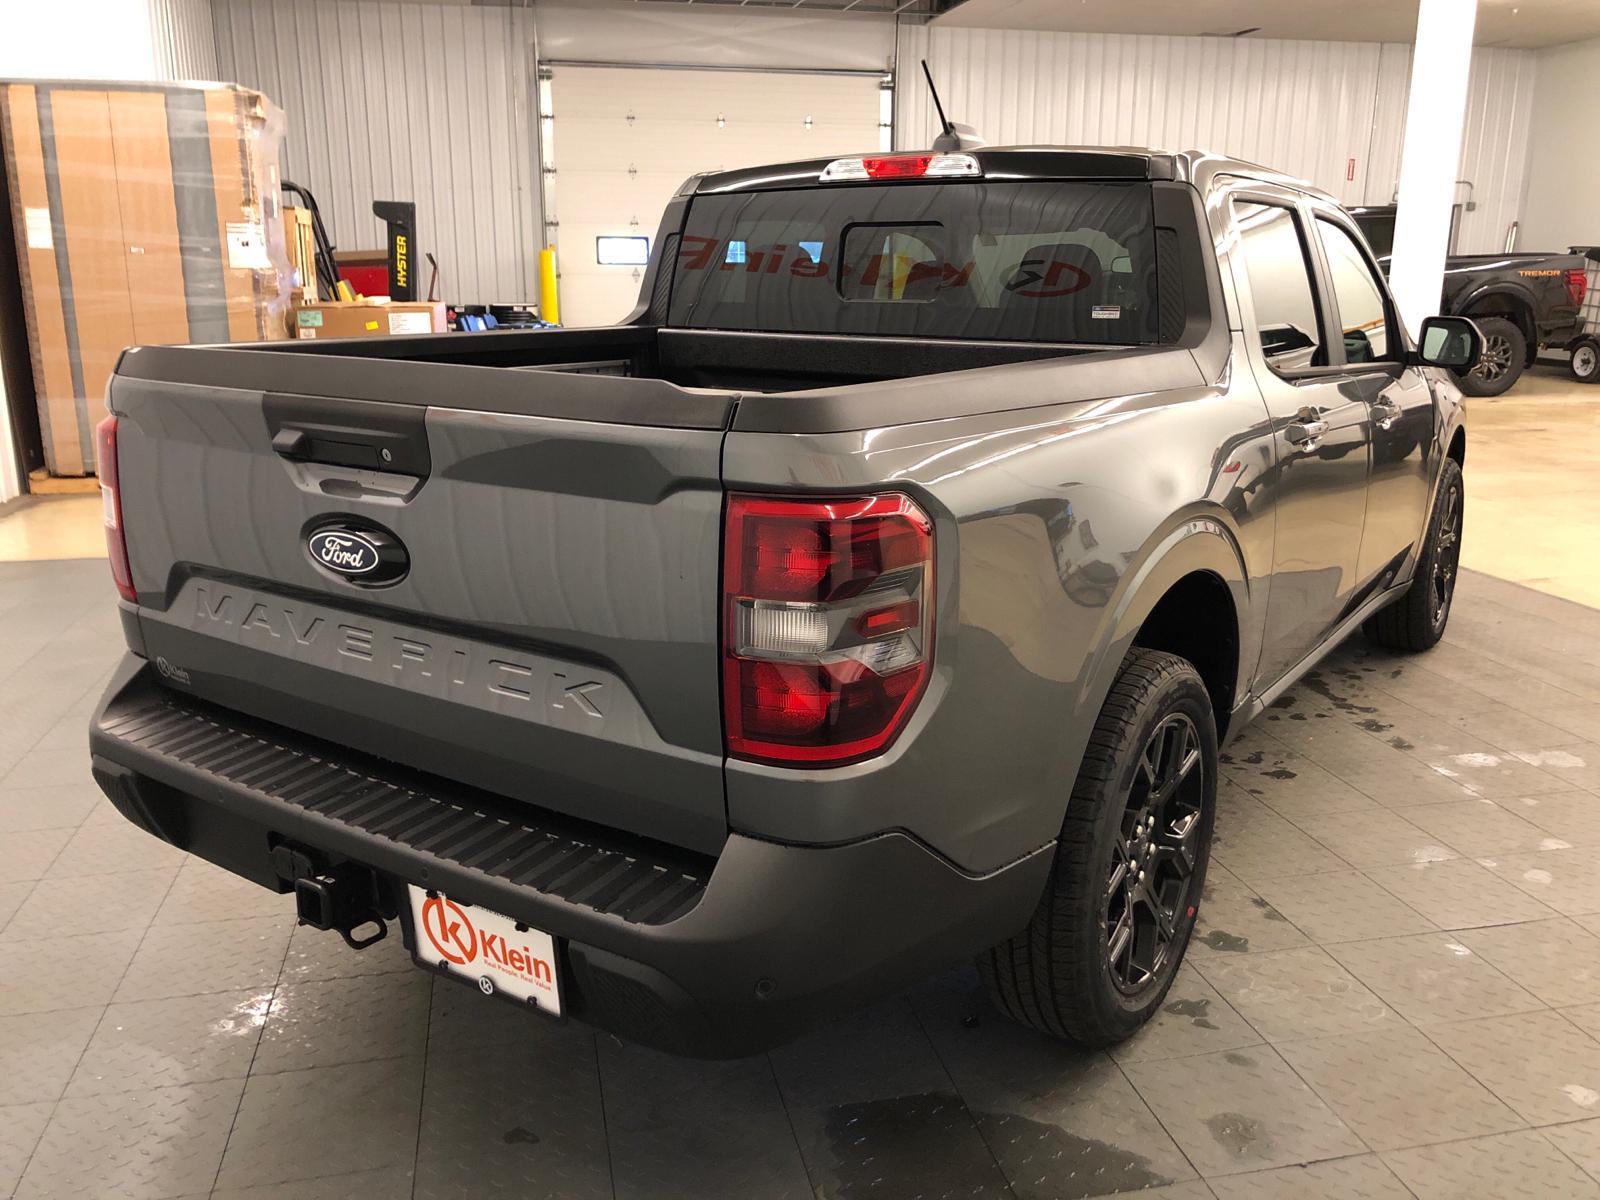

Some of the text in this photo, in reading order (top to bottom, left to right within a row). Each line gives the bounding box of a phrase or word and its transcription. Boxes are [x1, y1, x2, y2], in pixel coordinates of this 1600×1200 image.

[396, 235, 407, 287] HYSTER
[1517, 269, 1561, 277] TREMOR
[321, 536, 364, 568] Ford
[196, 588, 603, 718] MAVERICK
[479, 929, 552, 984] Klein
[483, 958, 553, 993] Real People. Real Value.
